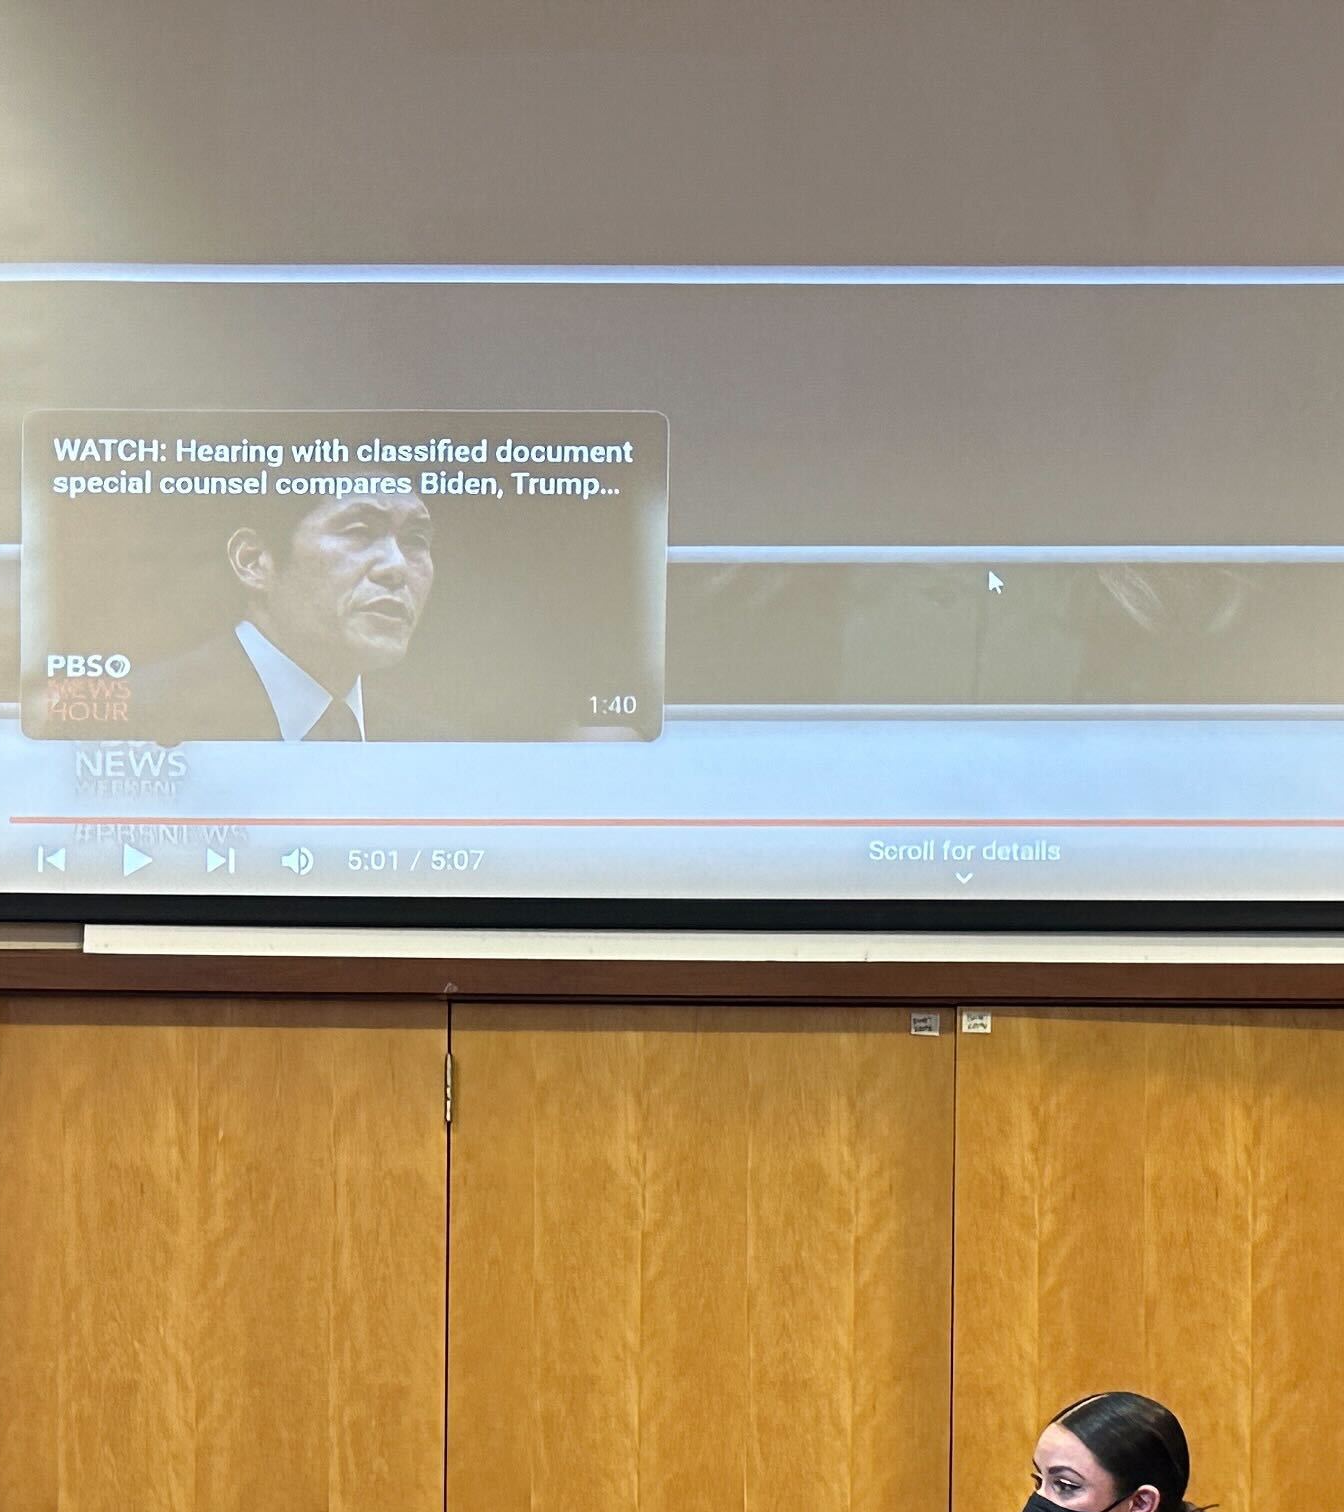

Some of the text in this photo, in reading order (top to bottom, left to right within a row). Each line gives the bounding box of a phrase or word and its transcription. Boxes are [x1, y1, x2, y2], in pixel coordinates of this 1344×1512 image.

[53, 438, 634, 468] WATCH: Hearing with classified document
[53, 470, 620, 500] special counsel compares Biden, Trump...
[47, 654, 104, 678] PBS
[47, 701, 129, 721] HOUR
[589, 695, 637, 715] 1:40
[74, 750, 188, 777] NEWS
[347, 850, 399, 871] 5:01
[430, 850, 485, 871] 5:07
[868, 839, 1061, 861] Scroll for details
